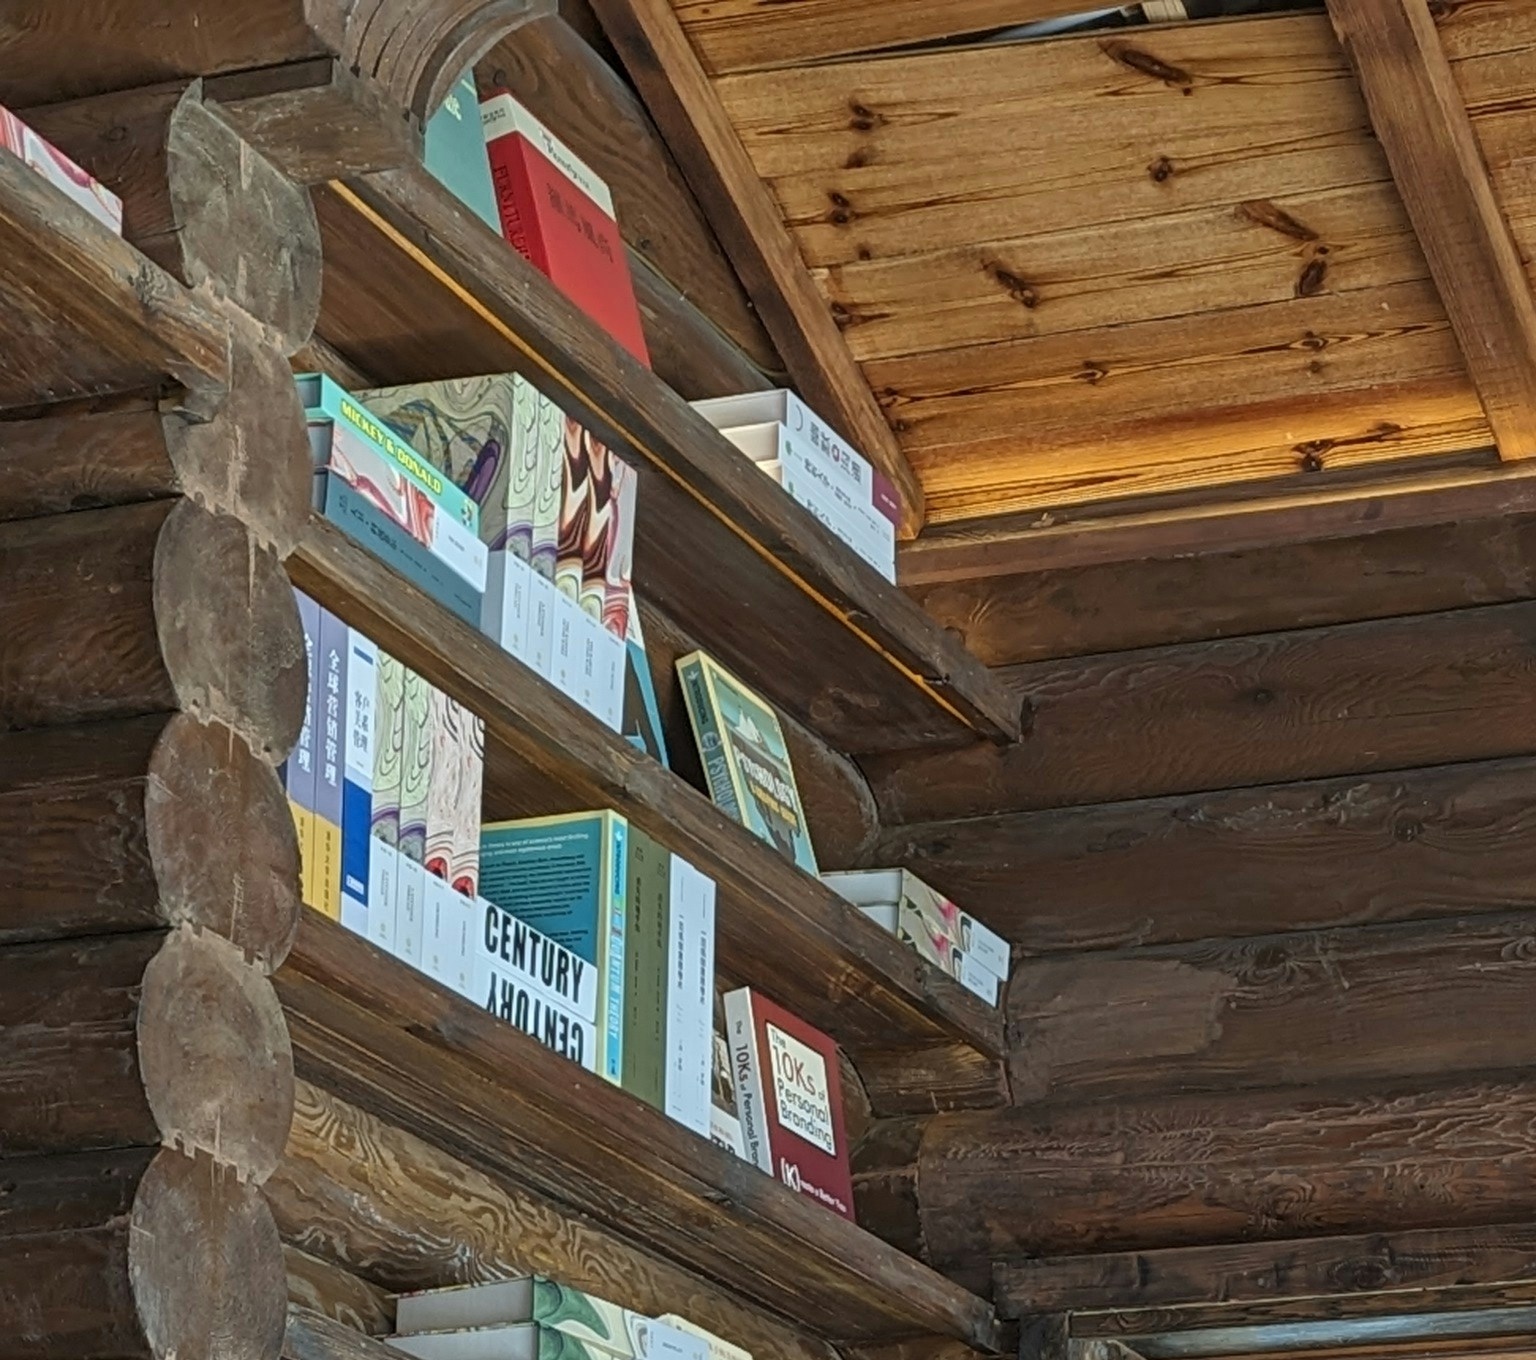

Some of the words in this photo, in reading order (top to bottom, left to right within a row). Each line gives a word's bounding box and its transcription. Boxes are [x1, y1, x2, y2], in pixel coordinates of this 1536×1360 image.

[340, 399, 384, 447] MICKEY
[384, 439, 396, 457] &
[397, 448, 442, 496] DONALD
[325, 648, 341, 788] 全球营销管理
[484, 904, 584, 1004] CENTURY
[609, 936, 623, 995] QUANTUM
[487, 971, 584, 1067] CENTURY
[608, 996, 620, 1040] THEORY
[770, 1029, 787, 1048] The
[735, 1044, 752, 1083] 10Ks
[771, 1045, 816, 1096] 10Ks
[742, 1093, 757, 1142] Personal
[776, 1077, 829, 1126] Personal
[780, 1099, 833, 1151] Branding
